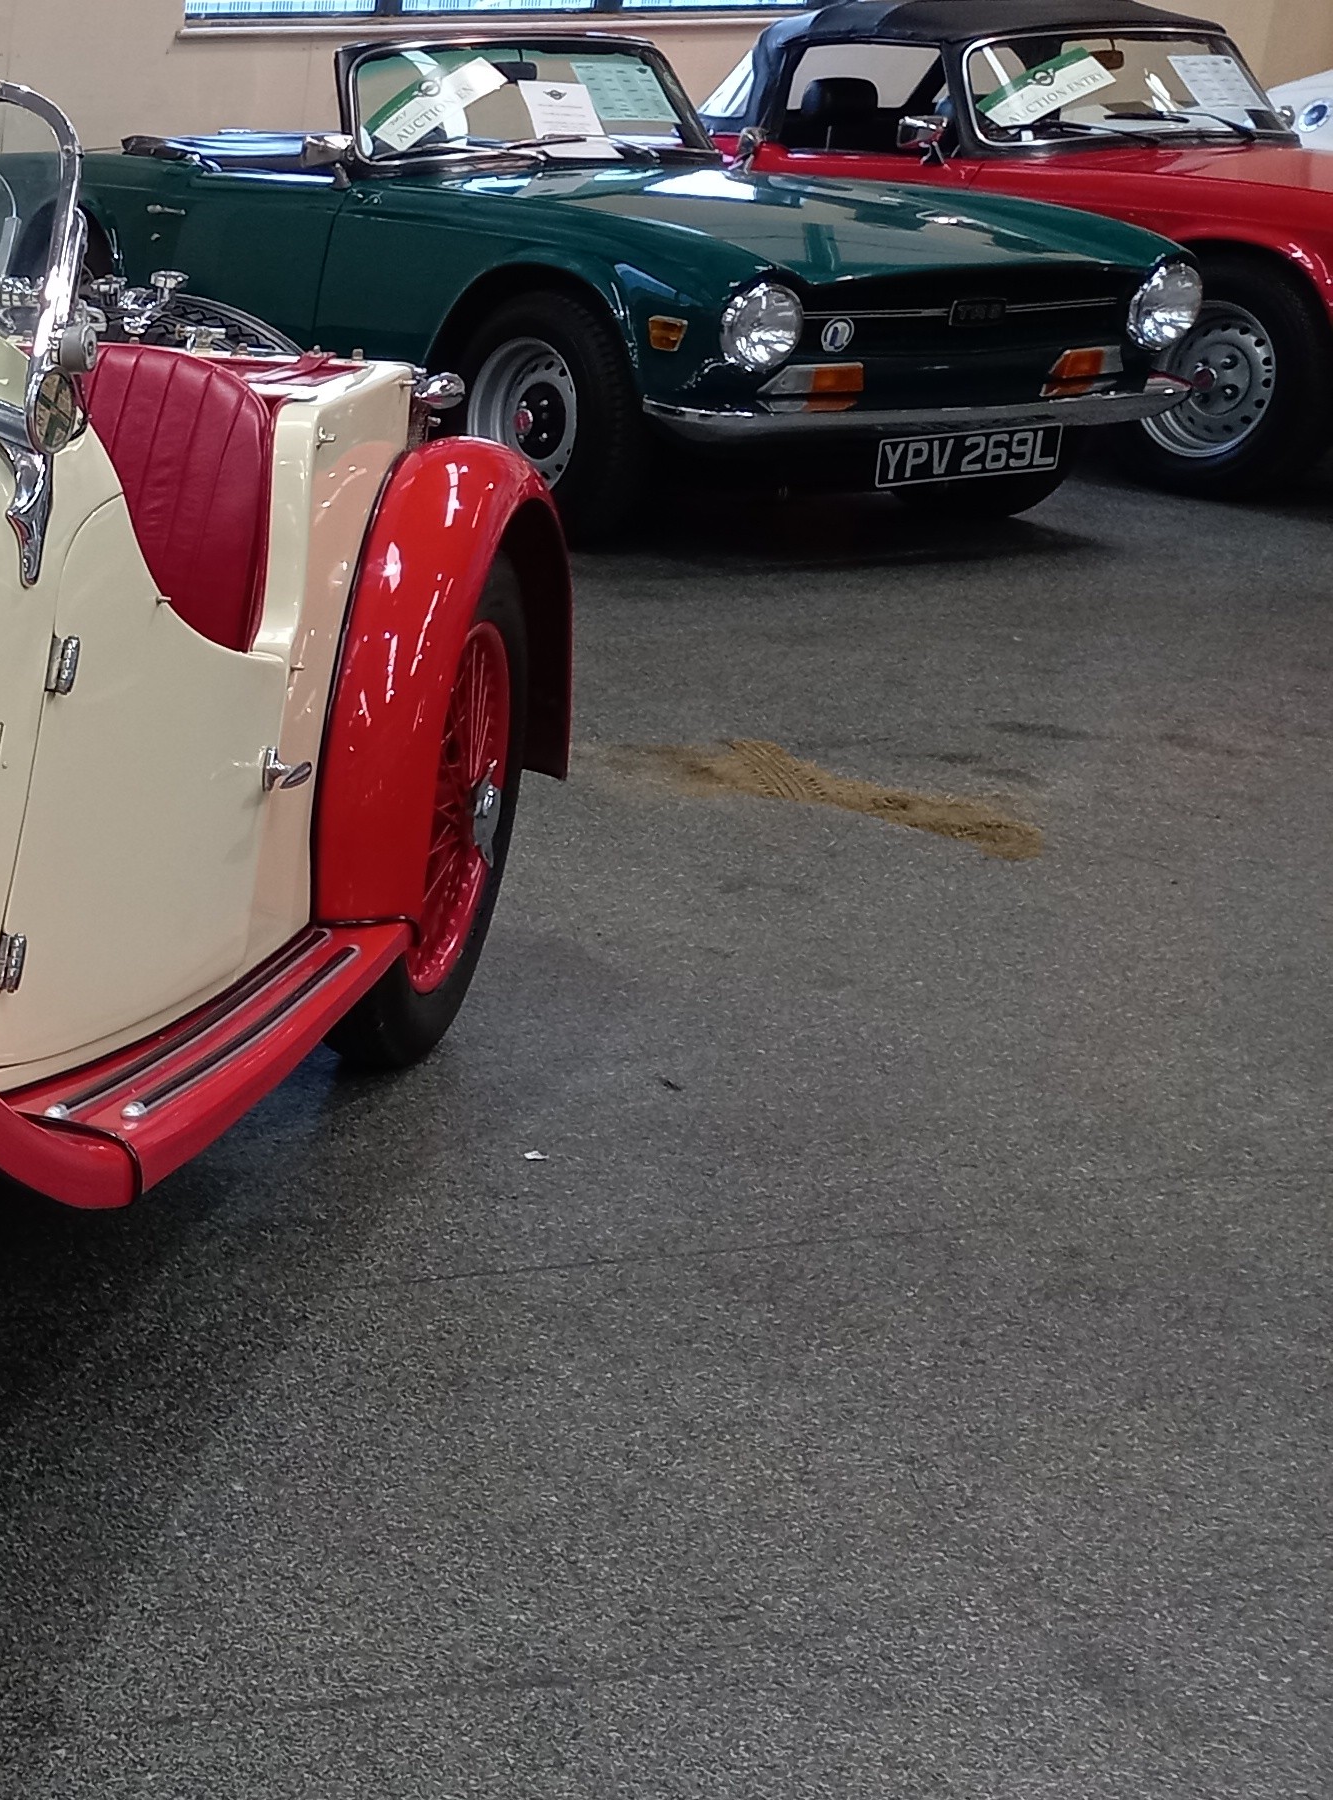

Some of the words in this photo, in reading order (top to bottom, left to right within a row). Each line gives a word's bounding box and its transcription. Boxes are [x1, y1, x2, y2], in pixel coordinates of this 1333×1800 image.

[1008, 89, 1067, 124] AUCTION
[1067, 71, 1105, 92] ENTRY
[884, 438, 954, 480] YPV
[960, 430, 1055, 473] 269L
